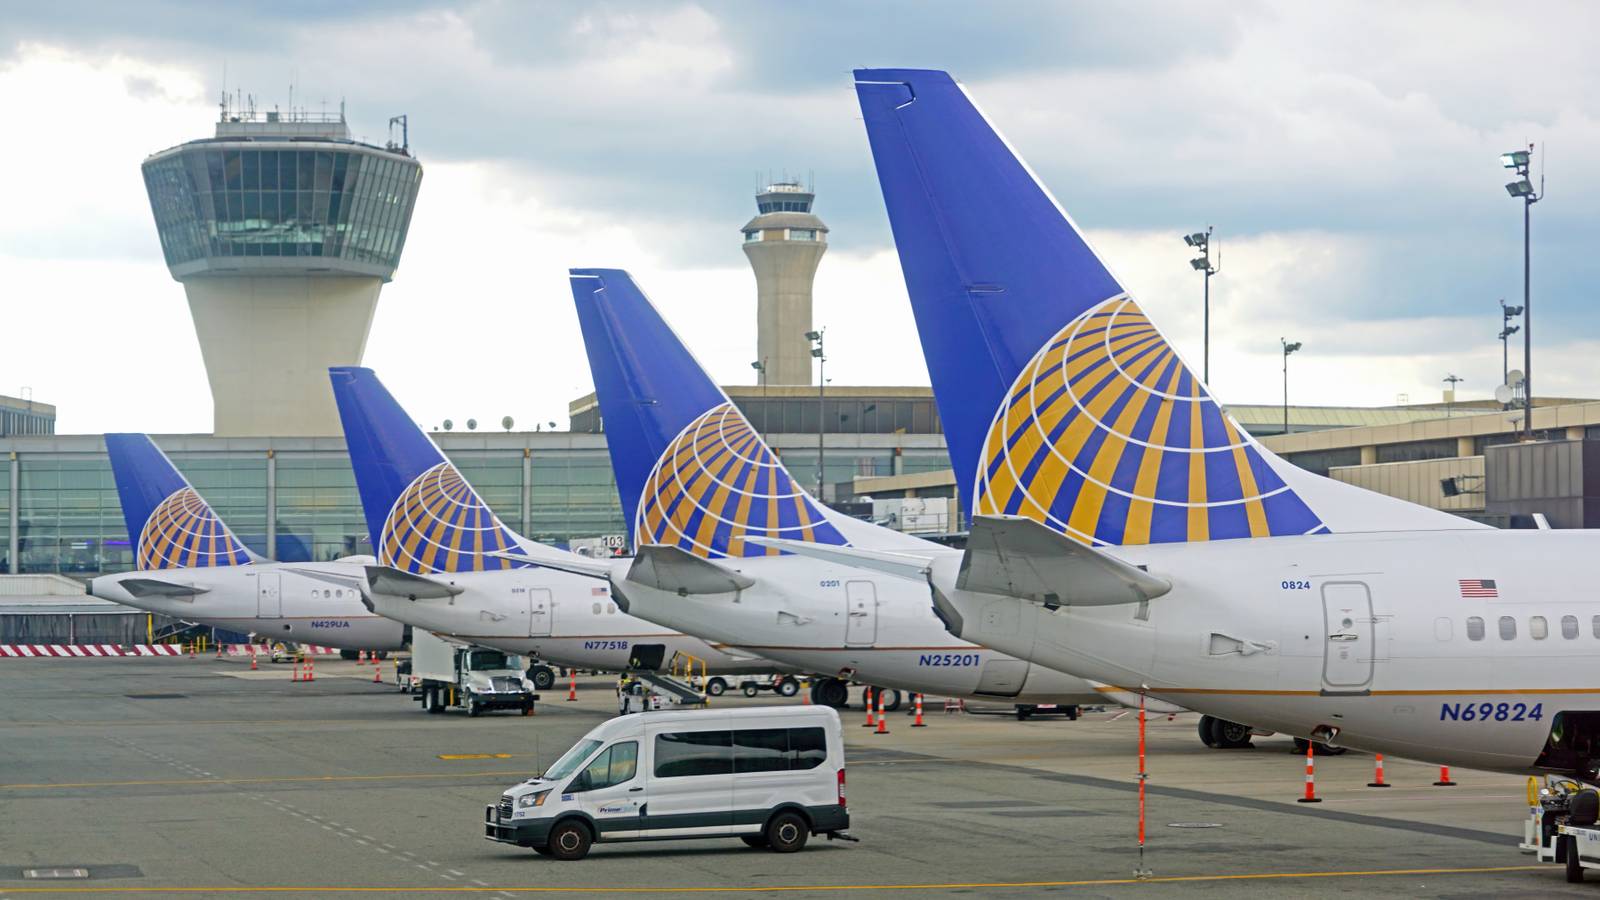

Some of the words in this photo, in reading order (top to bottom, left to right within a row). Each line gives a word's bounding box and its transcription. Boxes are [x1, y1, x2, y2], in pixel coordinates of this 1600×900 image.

[602, 536, 623, 547] 103
[1281, 580, 1311, 590] 0824
[311, 620, 350, 628] N429UA
[584, 641, 628, 650] N77518
[919, 654, 980, 666] N25201
[1440, 702, 1543, 721] N69824
